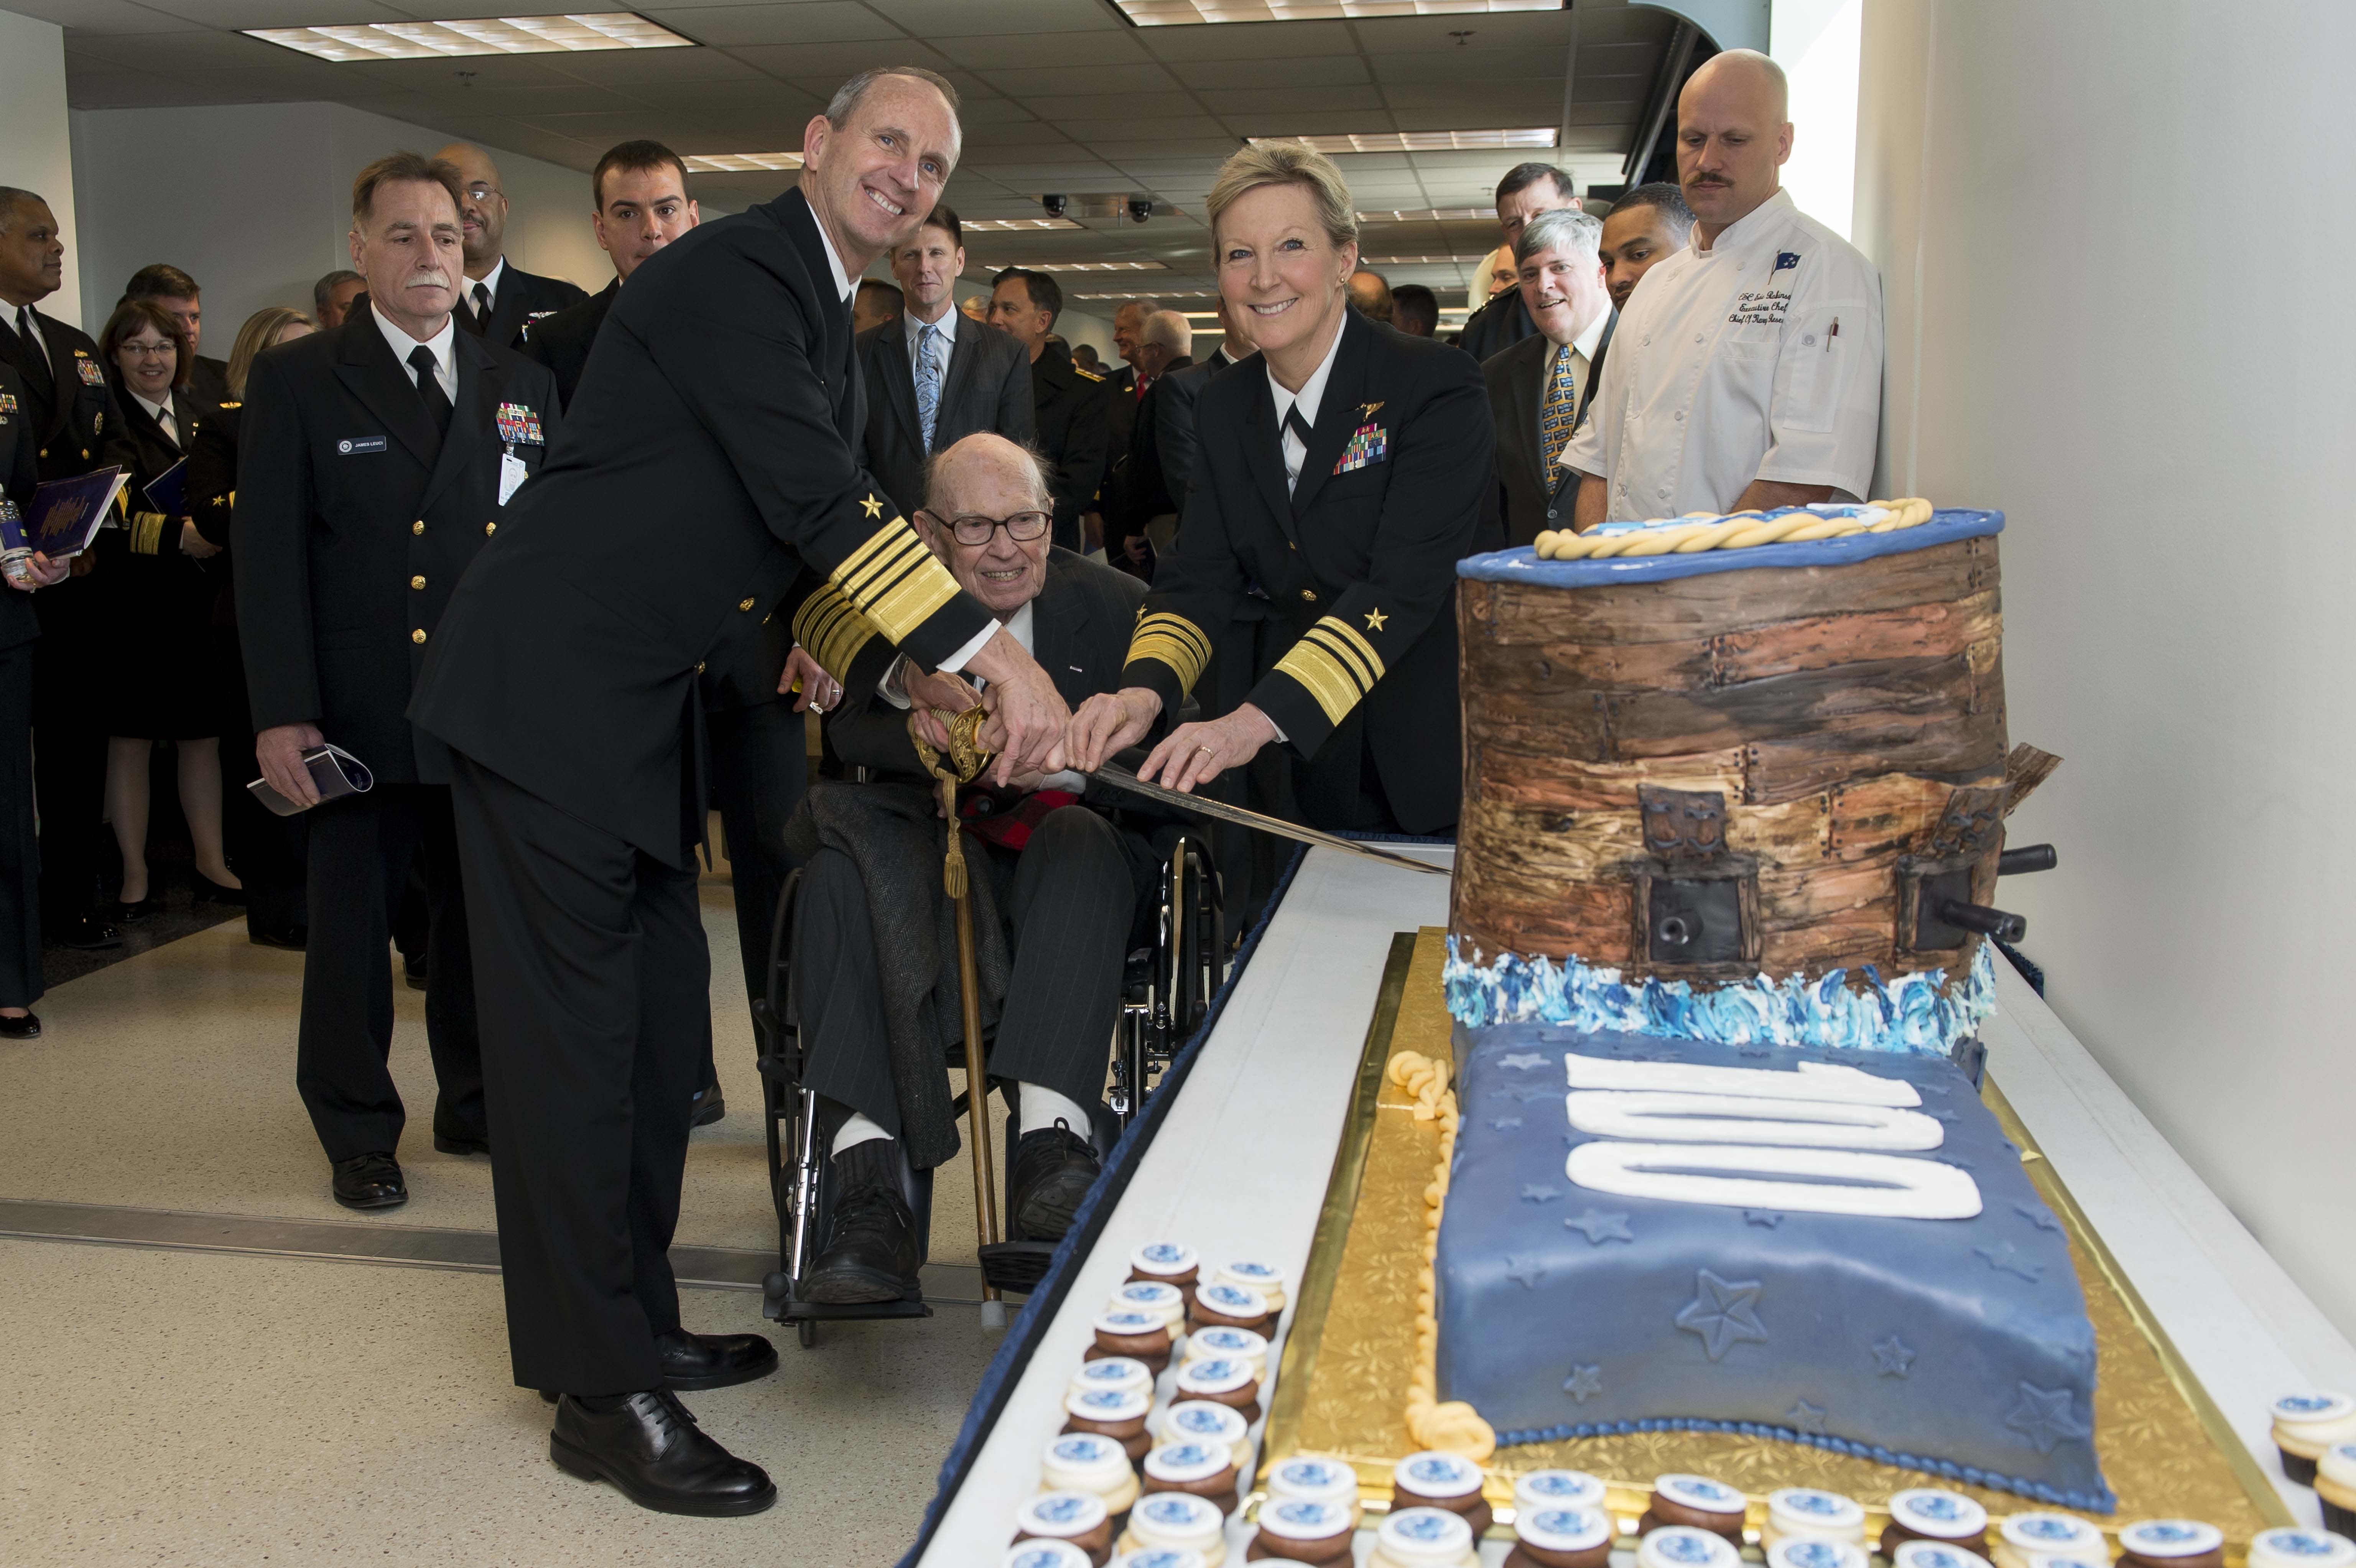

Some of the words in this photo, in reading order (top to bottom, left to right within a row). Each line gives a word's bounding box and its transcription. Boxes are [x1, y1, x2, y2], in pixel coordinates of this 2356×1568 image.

[1766, 290, 1791, 300] Robinso
[1739, 303, 1769, 312] Executive
[1771, 301, 1788, 313] Chef
[1729, 314, 1745, 325] Chief
[1752, 314, 1768, 325] Navy
[1565, 1053, 1983, 1219] 100
